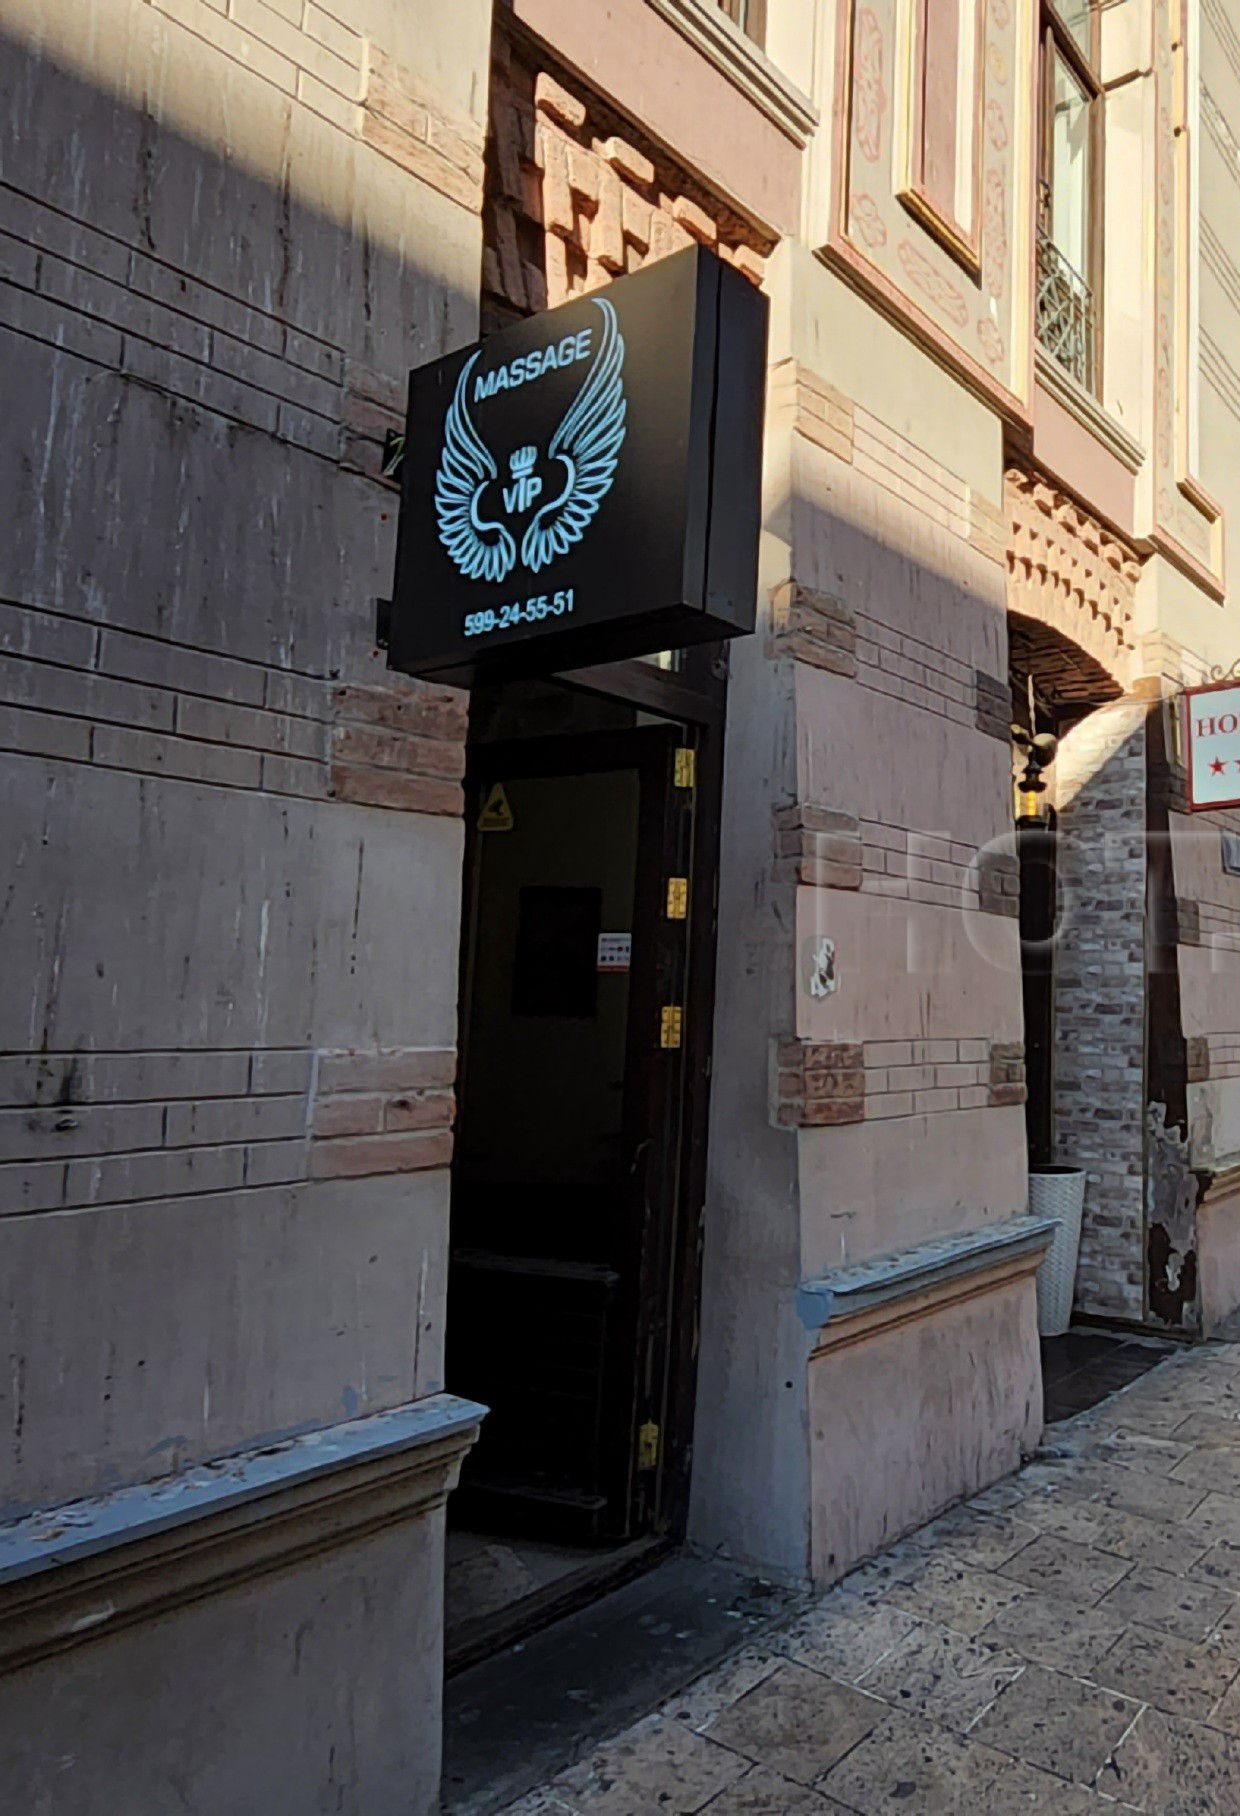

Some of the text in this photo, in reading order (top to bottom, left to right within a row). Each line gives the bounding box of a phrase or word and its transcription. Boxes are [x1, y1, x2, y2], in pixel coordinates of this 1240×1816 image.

[473, 327, 593, 403] MASSAGE
[502, 476, 543, 514] VIP
[463, 588, 575, 637] 599-24-55-51
